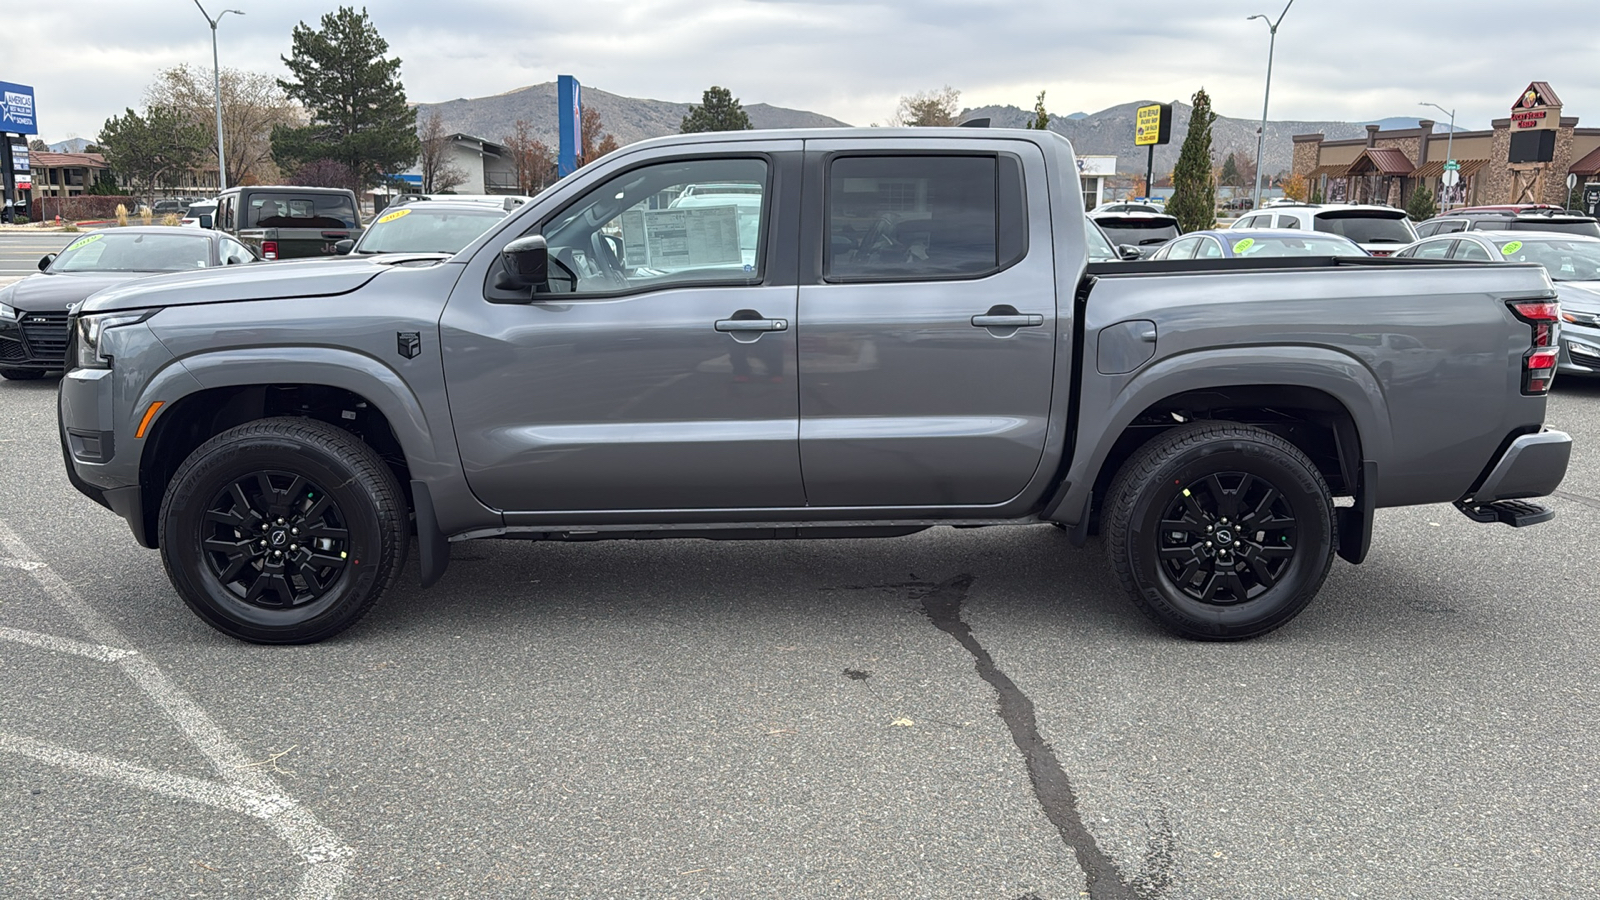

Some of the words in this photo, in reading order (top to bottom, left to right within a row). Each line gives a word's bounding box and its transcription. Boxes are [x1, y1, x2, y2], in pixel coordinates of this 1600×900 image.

[8, 94, 32, 106] AMERICAS
[1511, 113, 1526, 121] LUCKY
[1526, 111, 1546, 119] STRIKE
[1517, 120, 1536, 128] CASINO
[385, 211, 405, 221] 2022
[320, 243, 336, 253] Je
